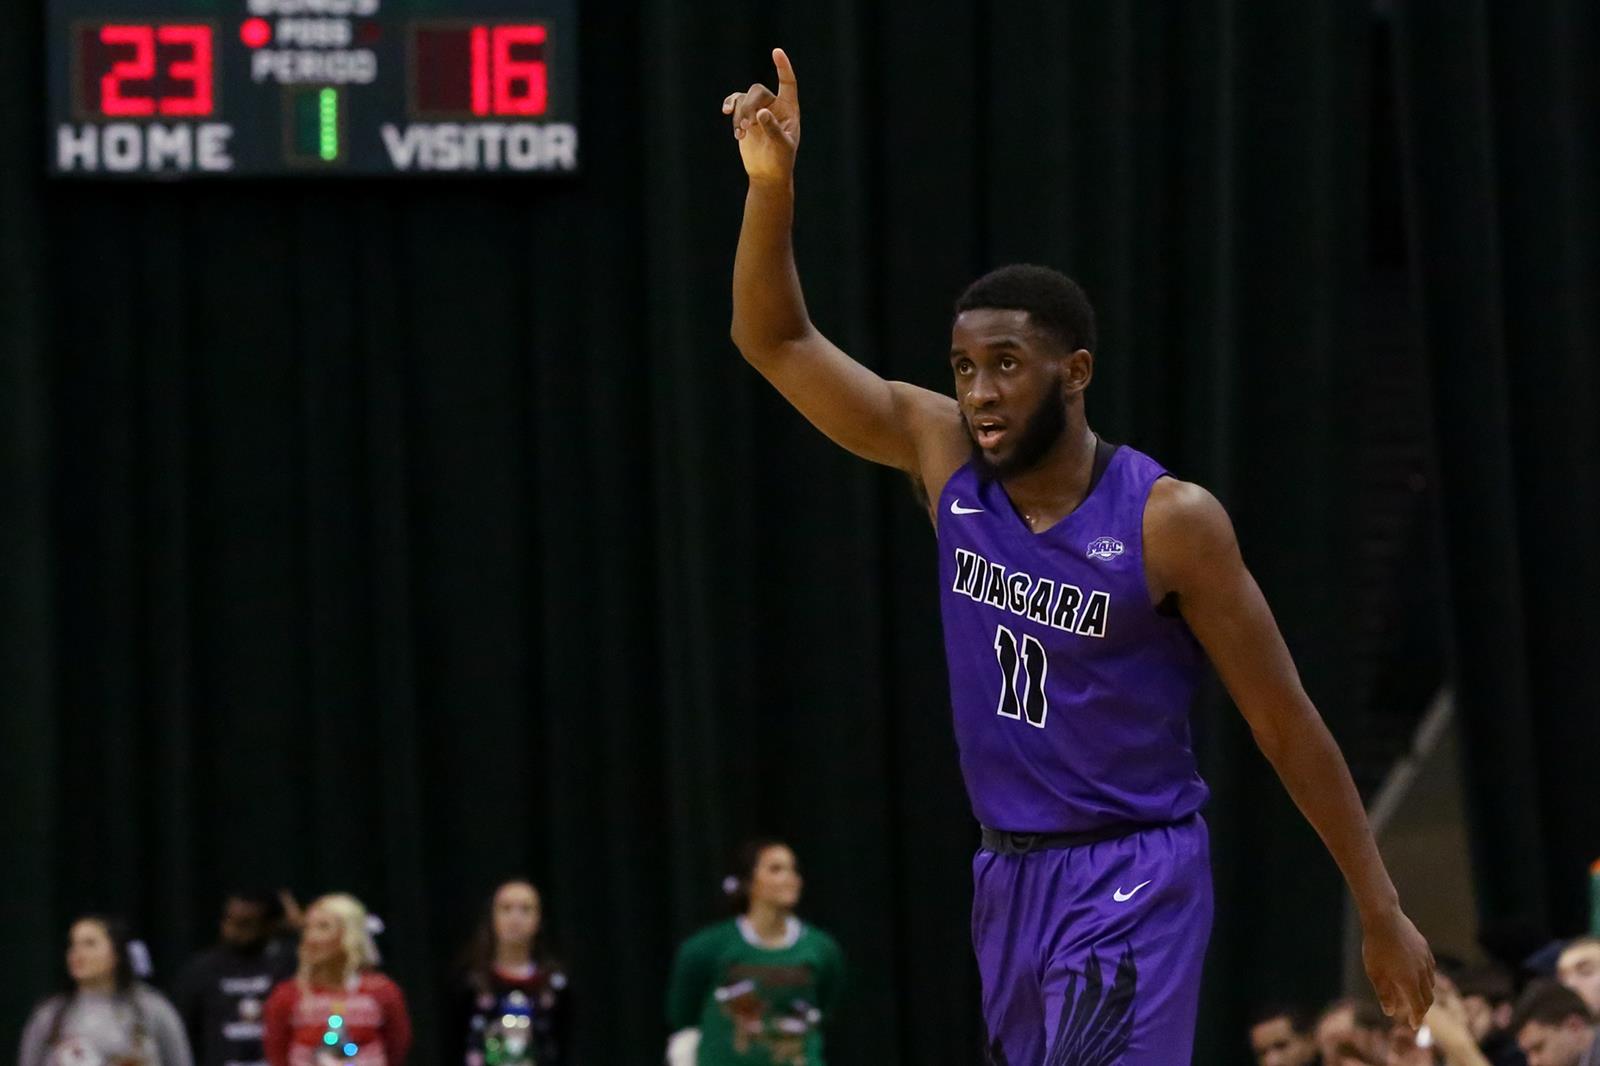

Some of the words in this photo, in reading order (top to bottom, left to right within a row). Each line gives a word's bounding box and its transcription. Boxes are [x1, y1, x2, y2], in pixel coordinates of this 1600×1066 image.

[99, 24, 213, 116] 23
[251, 51, 377, 83] PERIOD
[470, 25, 547, 116] 16
[57, 123, 234, 172] HOME
[380, 123, 578, 171] VISITOR
[1086, 541, 1124, 557] MAAC
[953, 548, 1110, 638] NIAGARA
[994, 624, 1048, 729] 11
